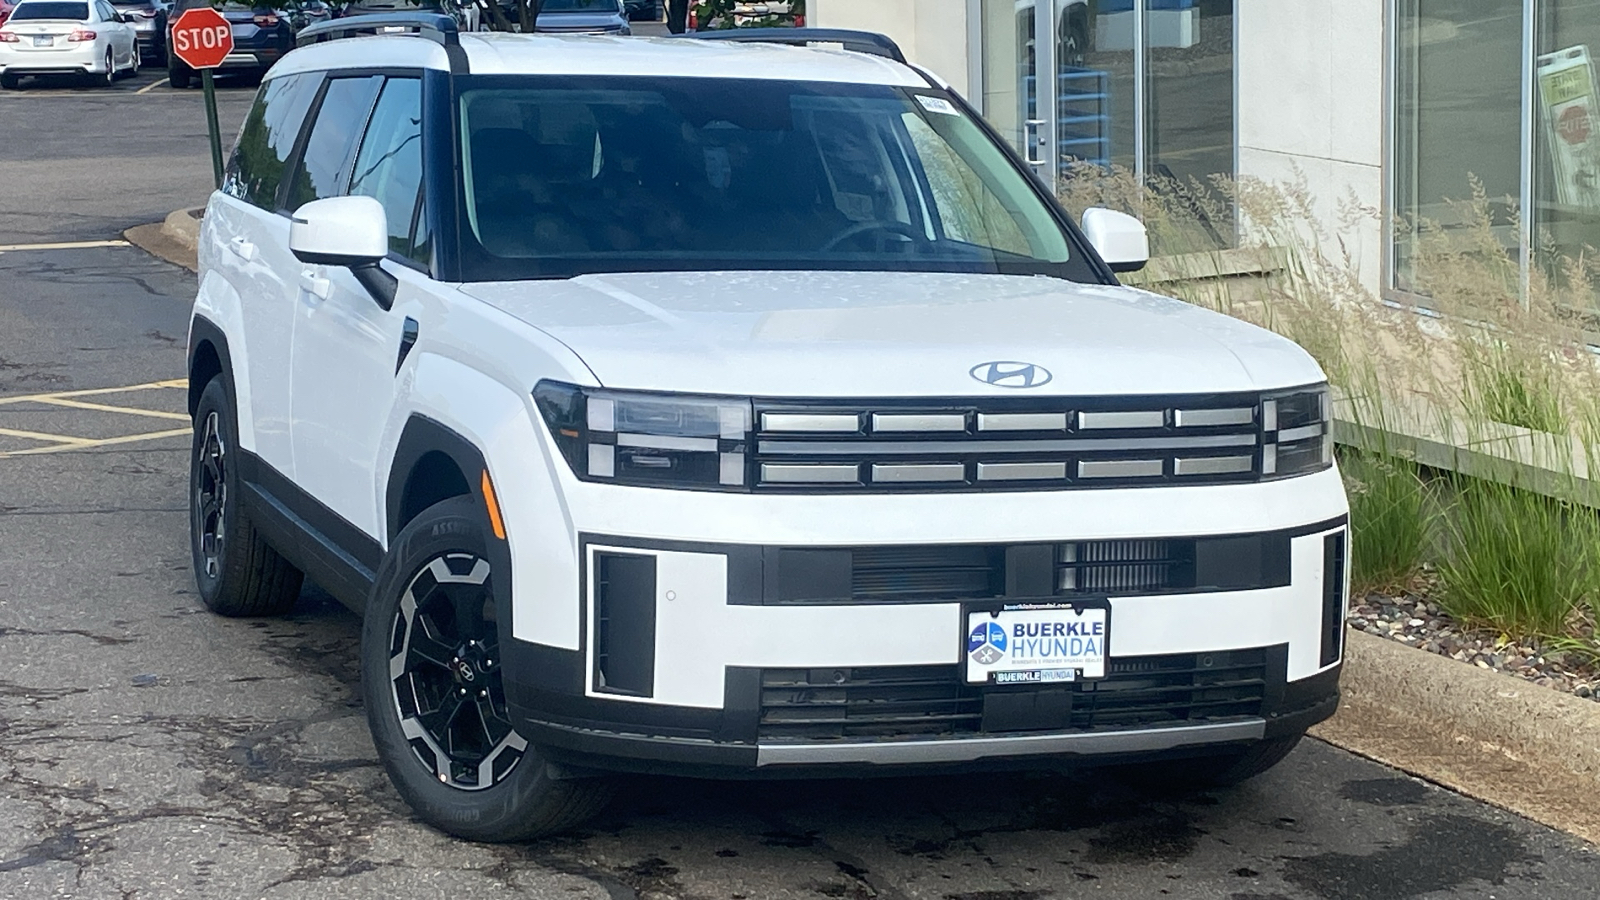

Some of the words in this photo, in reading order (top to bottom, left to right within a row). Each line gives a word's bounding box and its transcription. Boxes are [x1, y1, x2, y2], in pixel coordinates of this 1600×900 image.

[177, 25, 229, 51] STOP
[1013, 622, 1103, 637] BUERKLE
[1012, 638, 1103, 657] HYUNDAI
[999, 671, 1041, 682] BUERKLE
[1041, 670, 1074, 680] HYUNDAI
